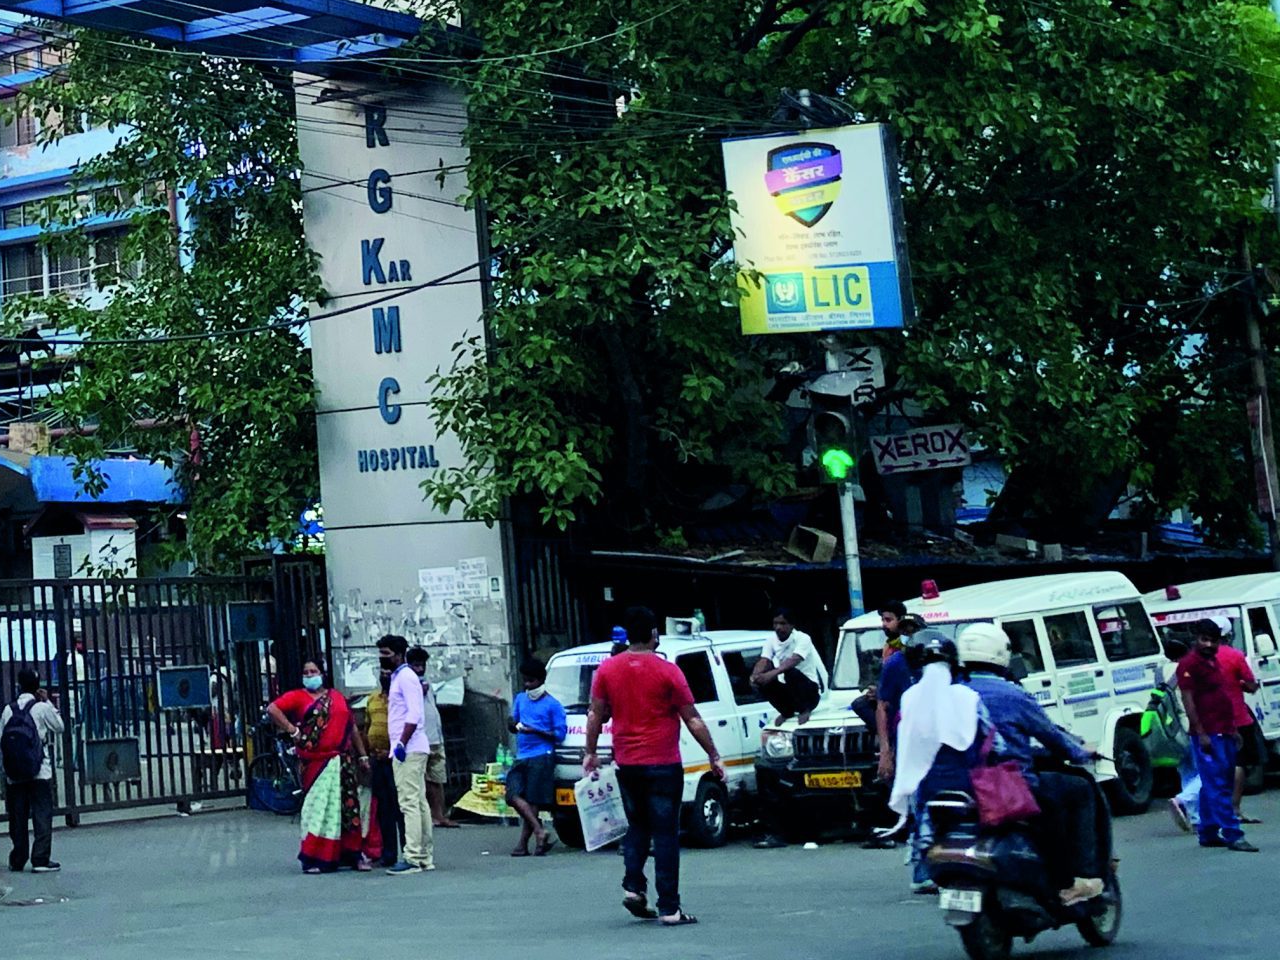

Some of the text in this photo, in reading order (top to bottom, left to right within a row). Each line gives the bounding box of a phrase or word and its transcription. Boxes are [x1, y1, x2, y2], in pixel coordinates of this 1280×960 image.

[361, 101, 413, 425] R G KAR M C
[811, 272, 862, 307] LIC
[358, 445, 439, 472] HOSPITAL
[872, 427, 968, 463] XEROX
